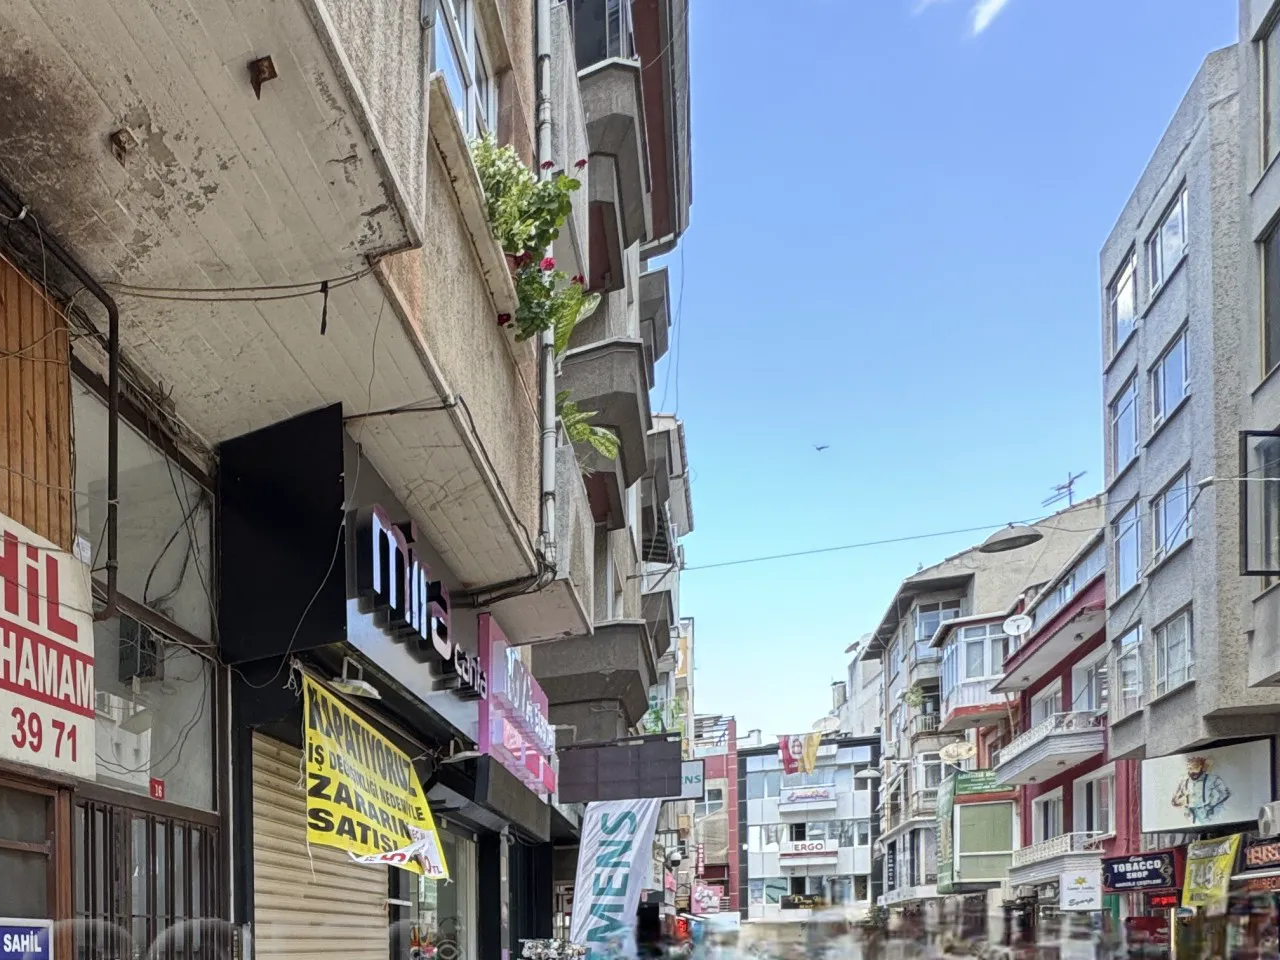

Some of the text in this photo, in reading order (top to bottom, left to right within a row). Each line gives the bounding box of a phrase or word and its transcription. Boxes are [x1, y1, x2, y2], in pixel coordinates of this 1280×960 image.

[11, 706, 43, 751] 39
[52, 719, 77, 762] 71
[307, 682, 417, 797] KAPATIYORUZ
[682, 774, 702, 785] NS
[794, 843, 824, 851] ERGO
[1112, 860, 1161, 873] TOBACCO
[1126, 871, 1149, 879] SHOP
[3, 931, 42, 952] SAHİL
